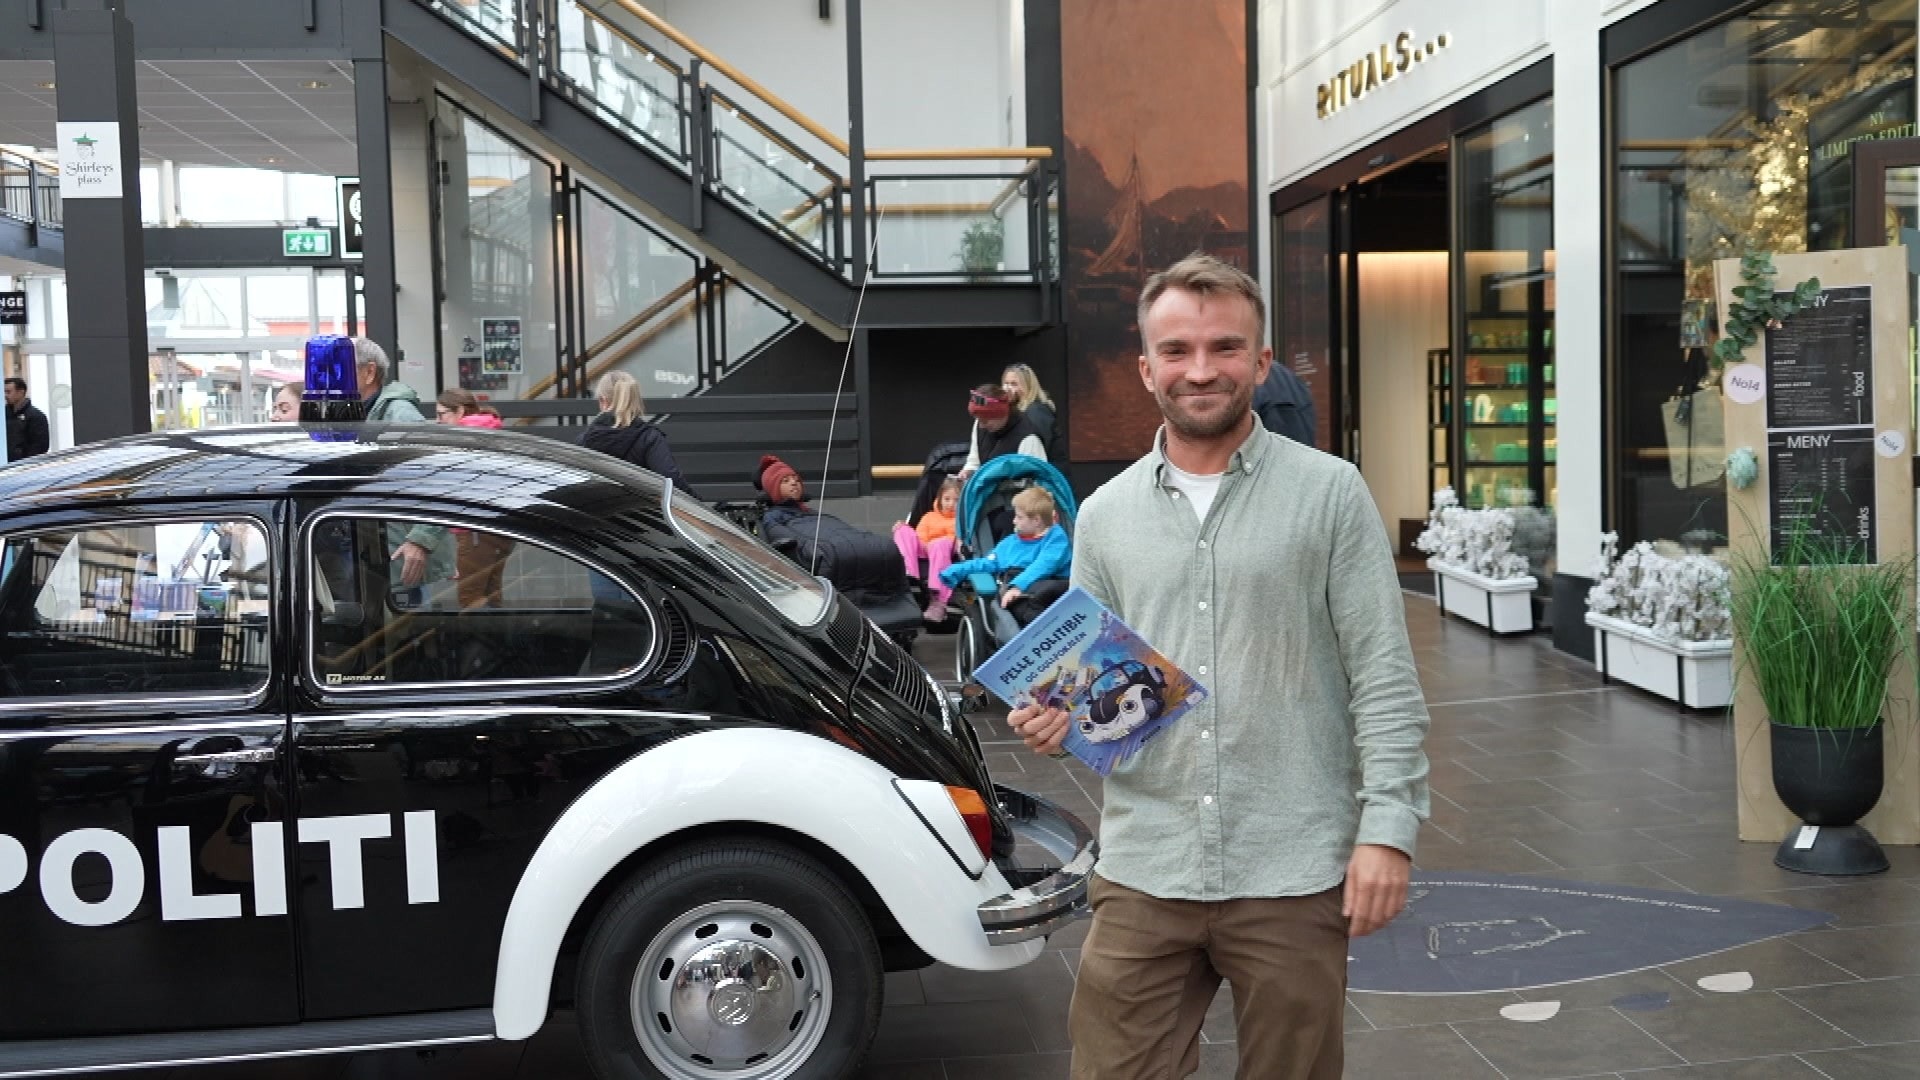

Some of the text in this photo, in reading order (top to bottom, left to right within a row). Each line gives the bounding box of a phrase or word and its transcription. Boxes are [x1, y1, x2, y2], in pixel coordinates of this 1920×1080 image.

[1870, 111, 1885, 126] NY
[1820, 134, 1874, 160] LIMI
[66, 162, 114, 177] Shirleys
[78, 175, 102, 187] plass
[1852, 371, 1865, 397] food
[1787, 434, 1832, 449] MENY
[1856, 506, 1870, 539] drinks
[1000, 654, 1035, 685] PELLE
[1032, 612, 1088, 660] POLITIBIL
